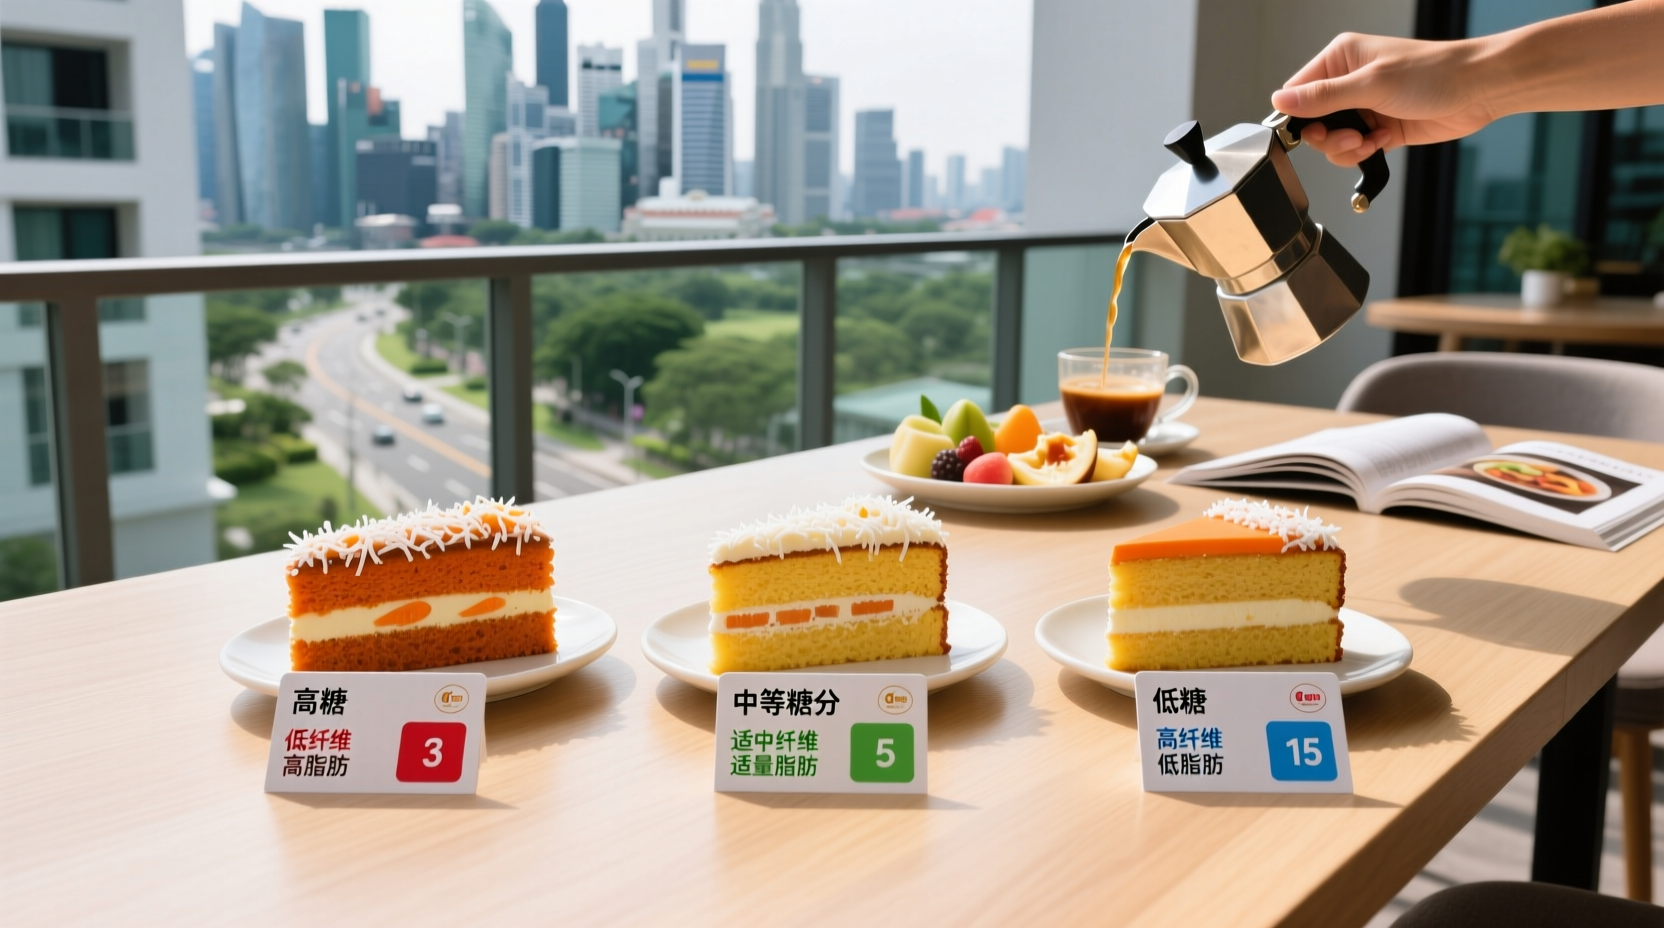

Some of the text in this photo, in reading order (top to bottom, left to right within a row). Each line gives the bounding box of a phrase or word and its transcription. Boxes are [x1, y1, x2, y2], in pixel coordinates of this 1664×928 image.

[292, 687, 349, 716] 高糖
[733, 687, 841, 717] 中等糖分
[1152, 686, 1208, 715] 低糖
[284, 728, 353, 752] 低纤维
[730, 728, 819, 753] 适中纤维
[1155, 726, 1224, 751] 高纤维
[1285, 737, 1323, 767] 15
[282, 754, 350, 778] 高脂肪
[422, 737, 444, 768] 3
[730, 753, 819, 778] 适量脂肪
[875, 738, 896, 768] 5
[1157, 752, 1225, 776] 低脂肪
